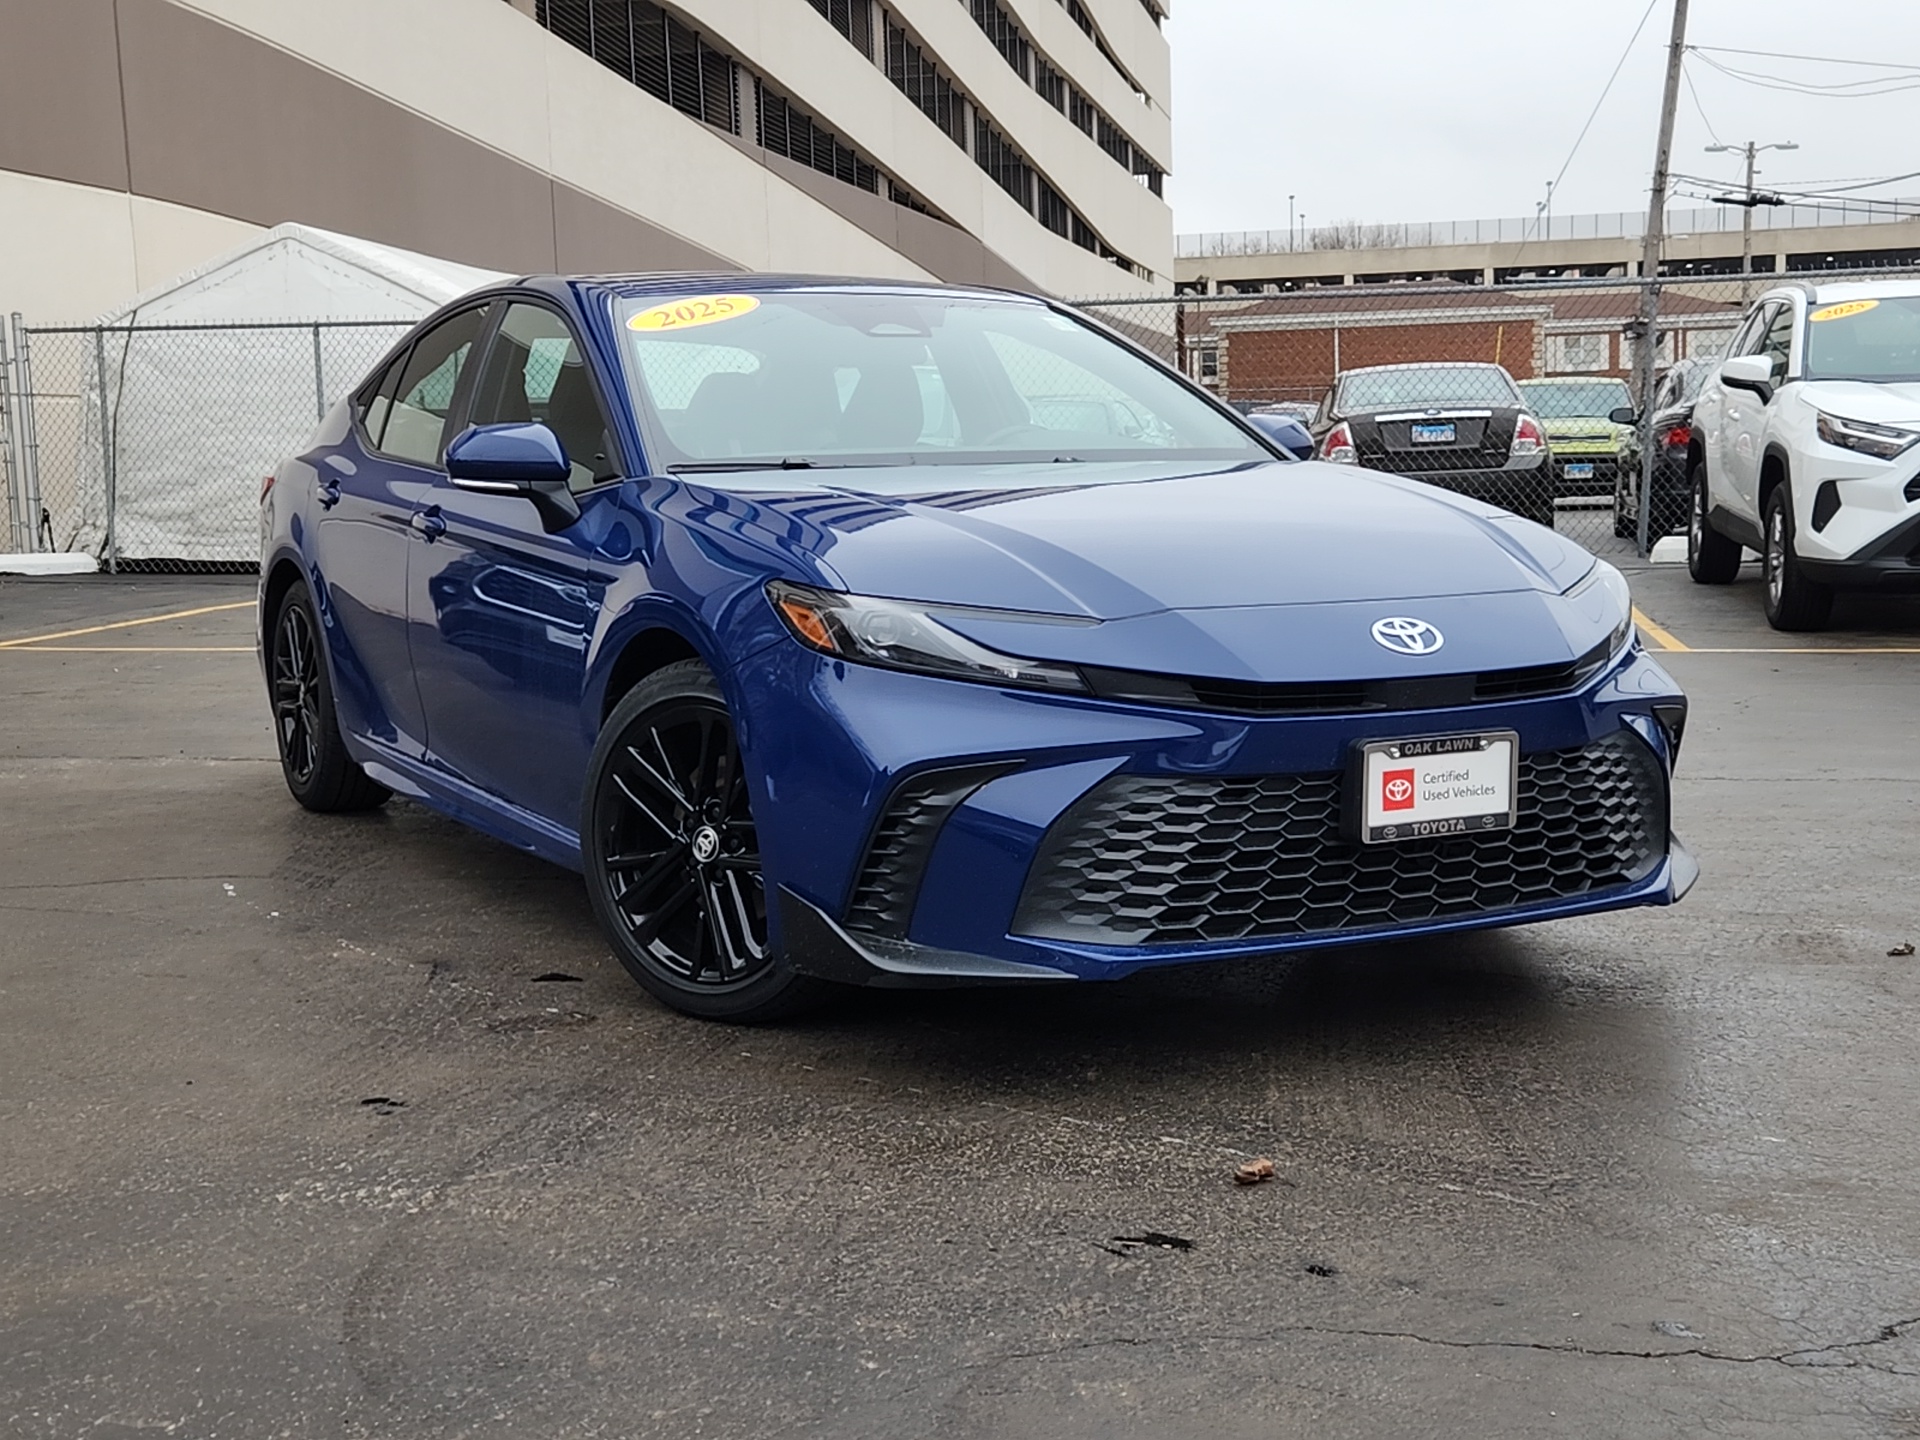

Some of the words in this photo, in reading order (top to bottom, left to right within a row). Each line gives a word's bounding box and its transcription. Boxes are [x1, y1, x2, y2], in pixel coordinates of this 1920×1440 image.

[653, 298, 734, 327] 2025
[1824, 303, 1865, 319] 2025
[1404, 743, 1432, 755] OAK
[1436, 738, 1475, 752] LAWN
[1422, 769, 1470, 785] Certified
[1422, 788, 1450, 801] Used
[1452, 785, 1496, 799] Vehicles
[1411, 819, 1466, 836] TOYOTA
